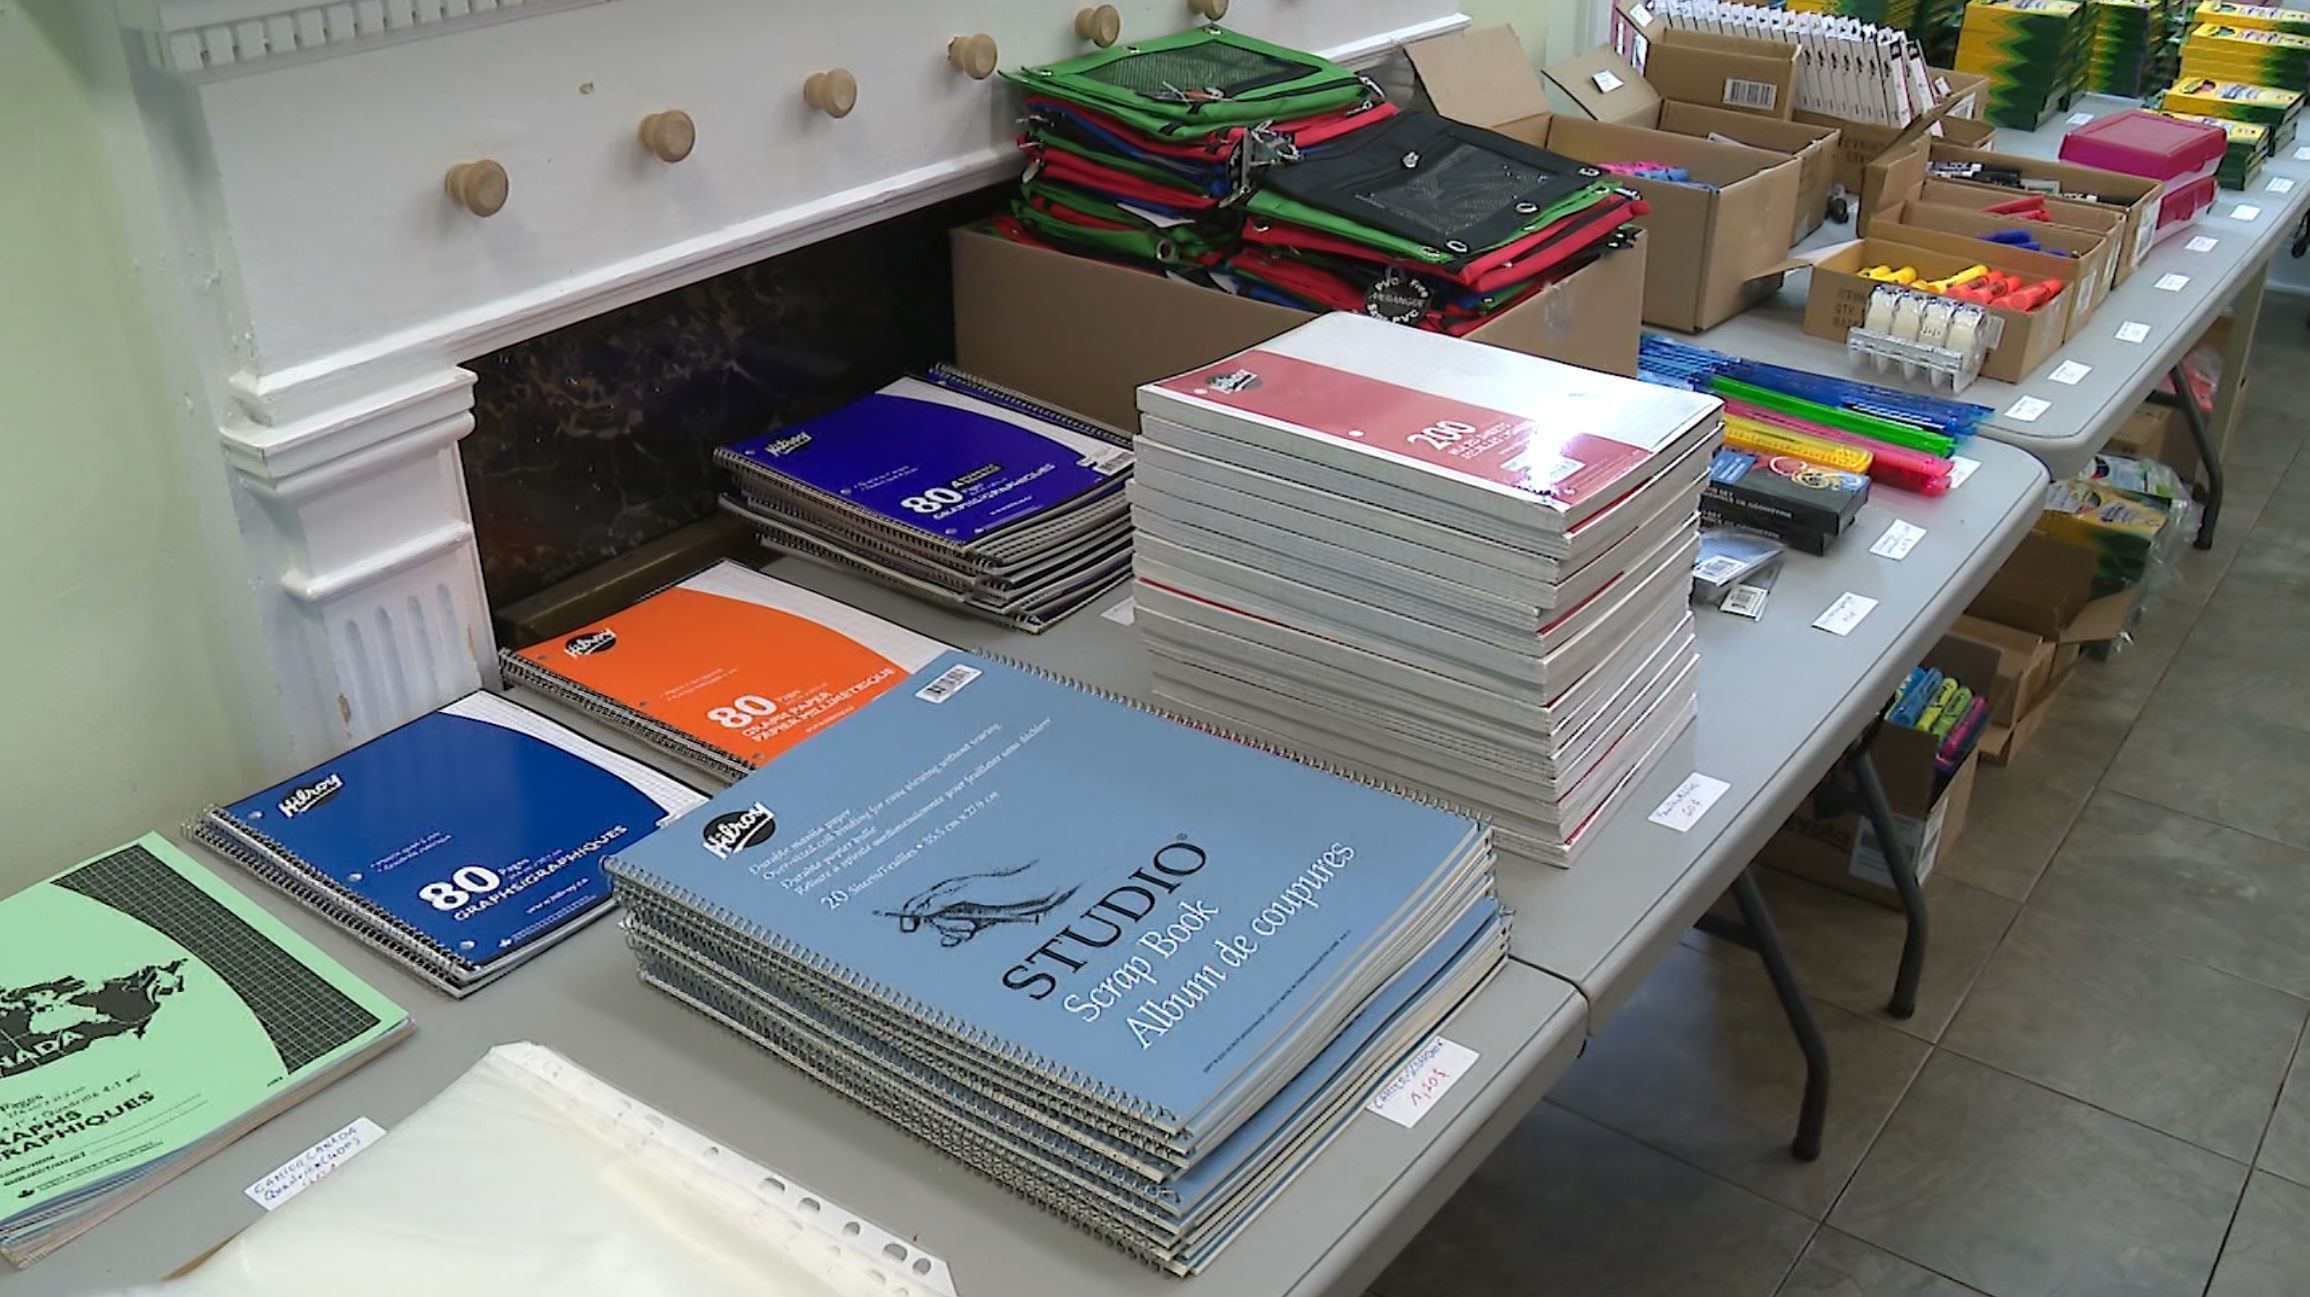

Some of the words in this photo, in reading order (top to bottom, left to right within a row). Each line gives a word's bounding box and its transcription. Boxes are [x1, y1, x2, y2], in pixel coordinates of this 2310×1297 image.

[1407, 420, 1476, 450] 200
[900, 486, 964, 514] 80
[707, 694, 778, 729] 80
[278, 774, 344, 818] Hilroy
[702, 800, 776, 861] Hilroy
[418, 865, 501, 912] 80
[820, 889, 850, 910] 20
[1002, 841, 1208, 1001] STUDIO
[1063, 955, 1158, 1024] Scrap
[1137, 900, 1220, 959] Book
[1125, 962, 1226, 1051] Album
[1213, 929, 1258, 968] de
[1251, 841, 1356, 937] coupures
[0, 1090, 155, 1162] RAPHIQUES
